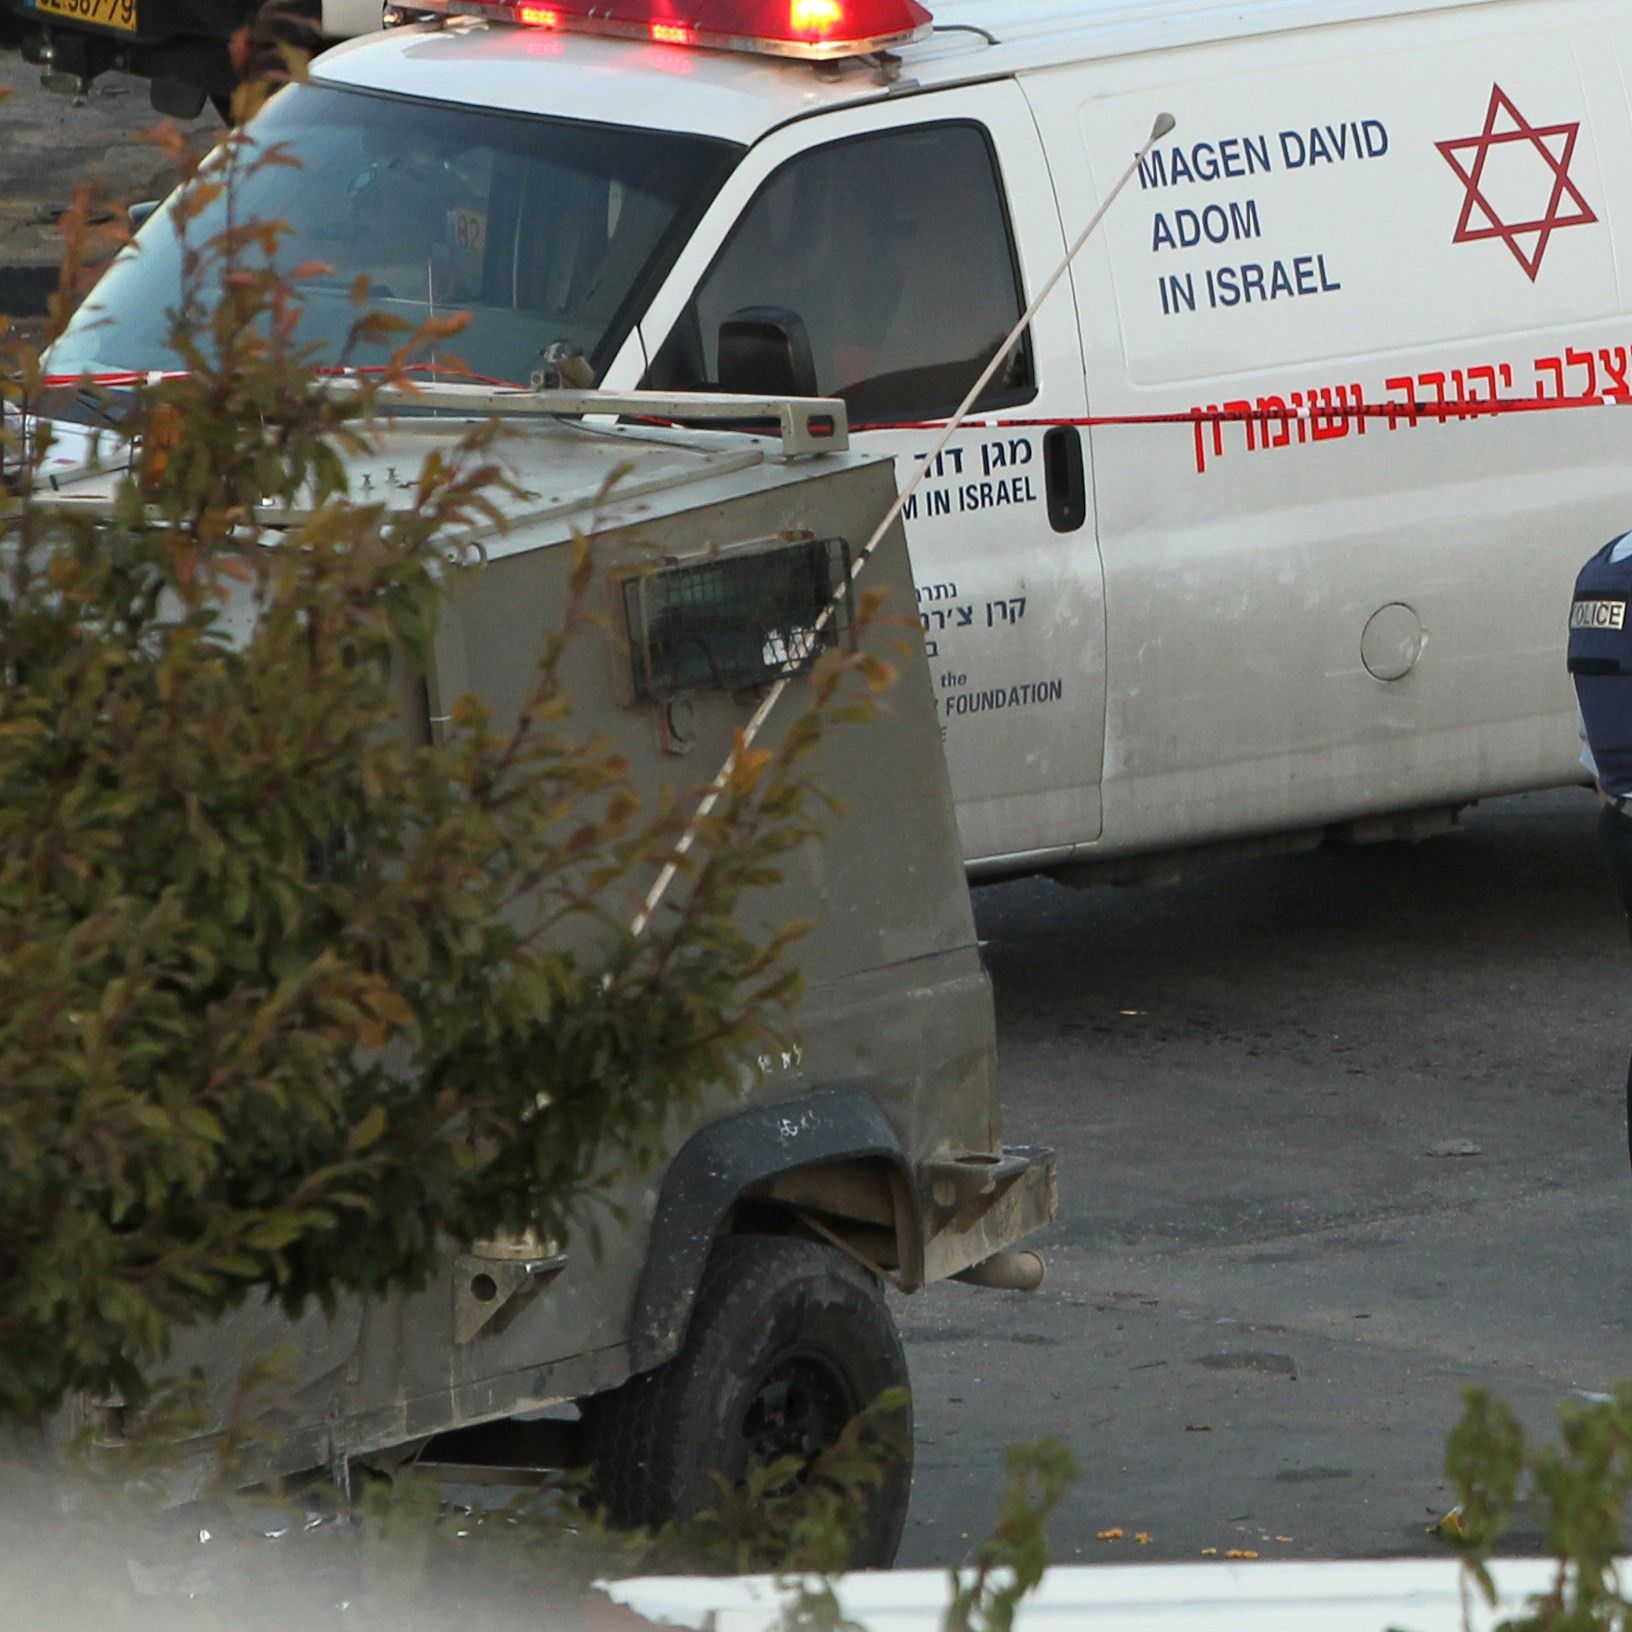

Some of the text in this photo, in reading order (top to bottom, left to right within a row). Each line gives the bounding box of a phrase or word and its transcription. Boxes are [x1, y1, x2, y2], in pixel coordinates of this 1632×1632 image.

[1135, 119, 1390, 190] MAGEN DAVID
[1151, 199, 1262, 252] ADOM
[1158, 254, 1342, 316] IN ISRAEL
[981, 437, 1033, 476] מגן
[926, 488, 950, 516] IN
[959, 476, 1037, 512] ISRAEL
[986, 597, 1026, 628] קרן
[1573, 603, 1623, 627] OLICE
[941, 671, 967, 688] the
[946, 678, 1063, 716] FOUNDATION
